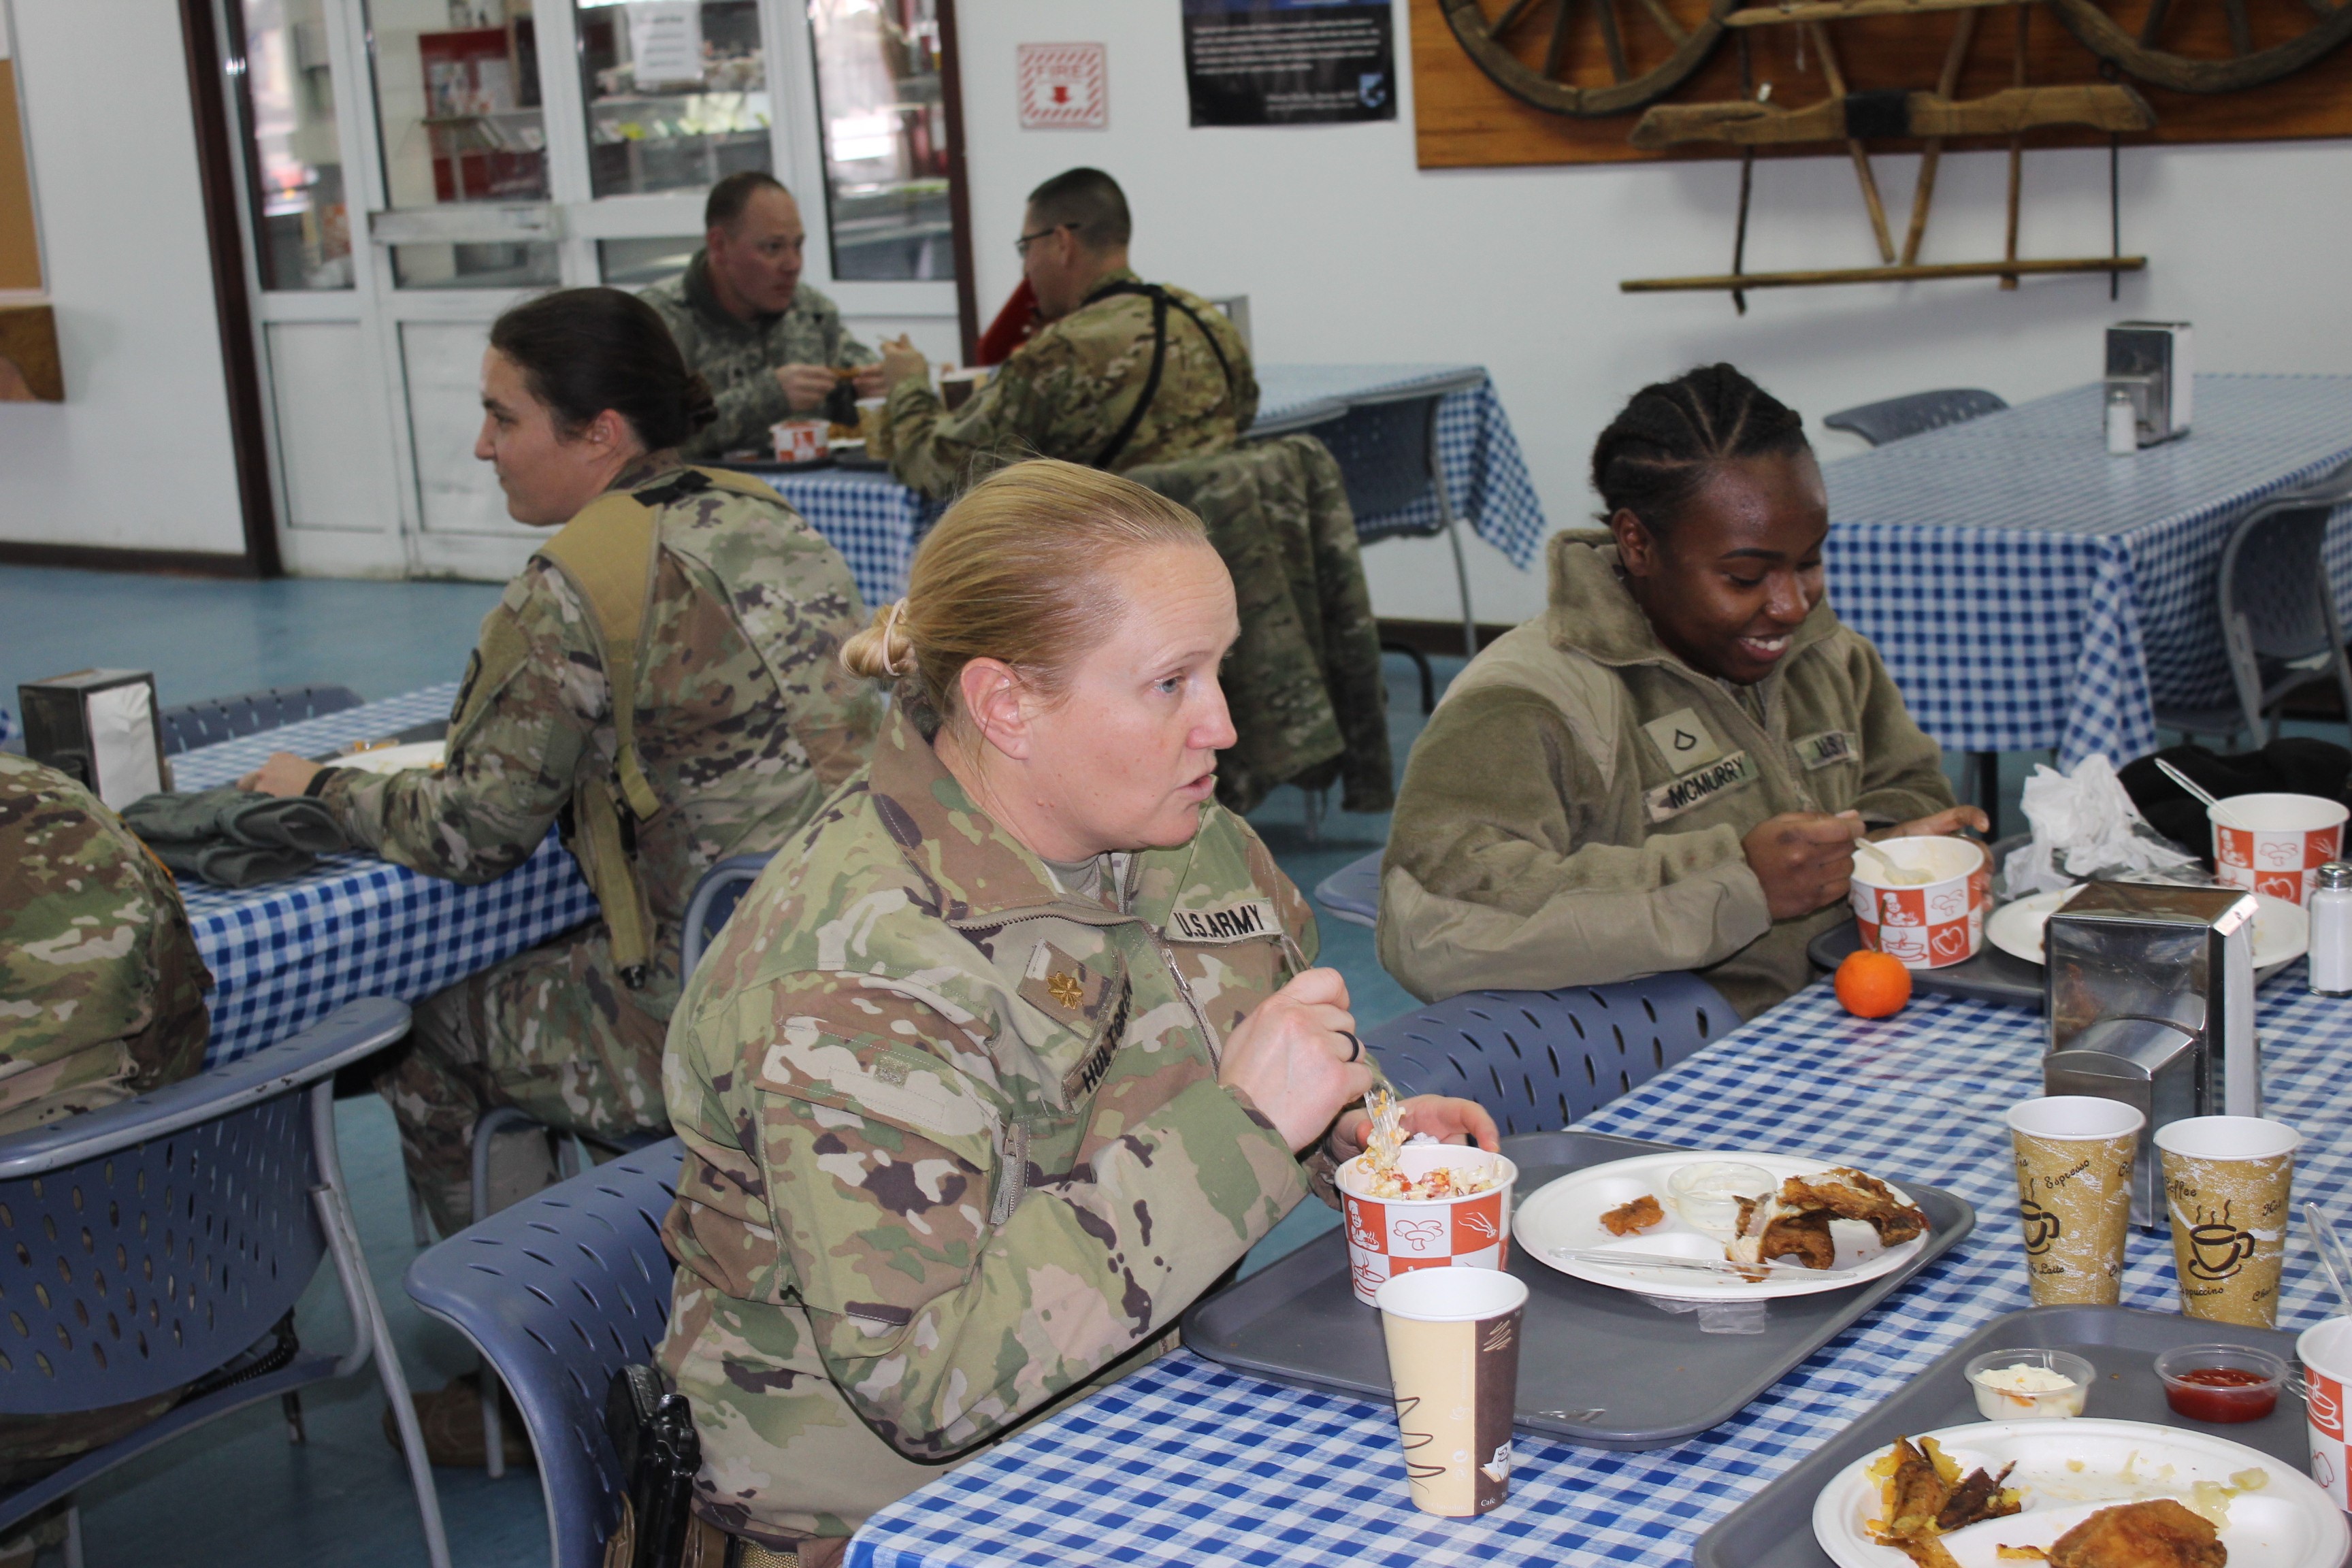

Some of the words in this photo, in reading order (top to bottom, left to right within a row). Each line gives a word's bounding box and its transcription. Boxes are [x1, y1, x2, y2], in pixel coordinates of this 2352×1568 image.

[1668, 756, 1746, 808] MCMURRY
[2044, 1160, 2090, 1189] Espresso
[2040, 1262, 2065, 1275] Latte
